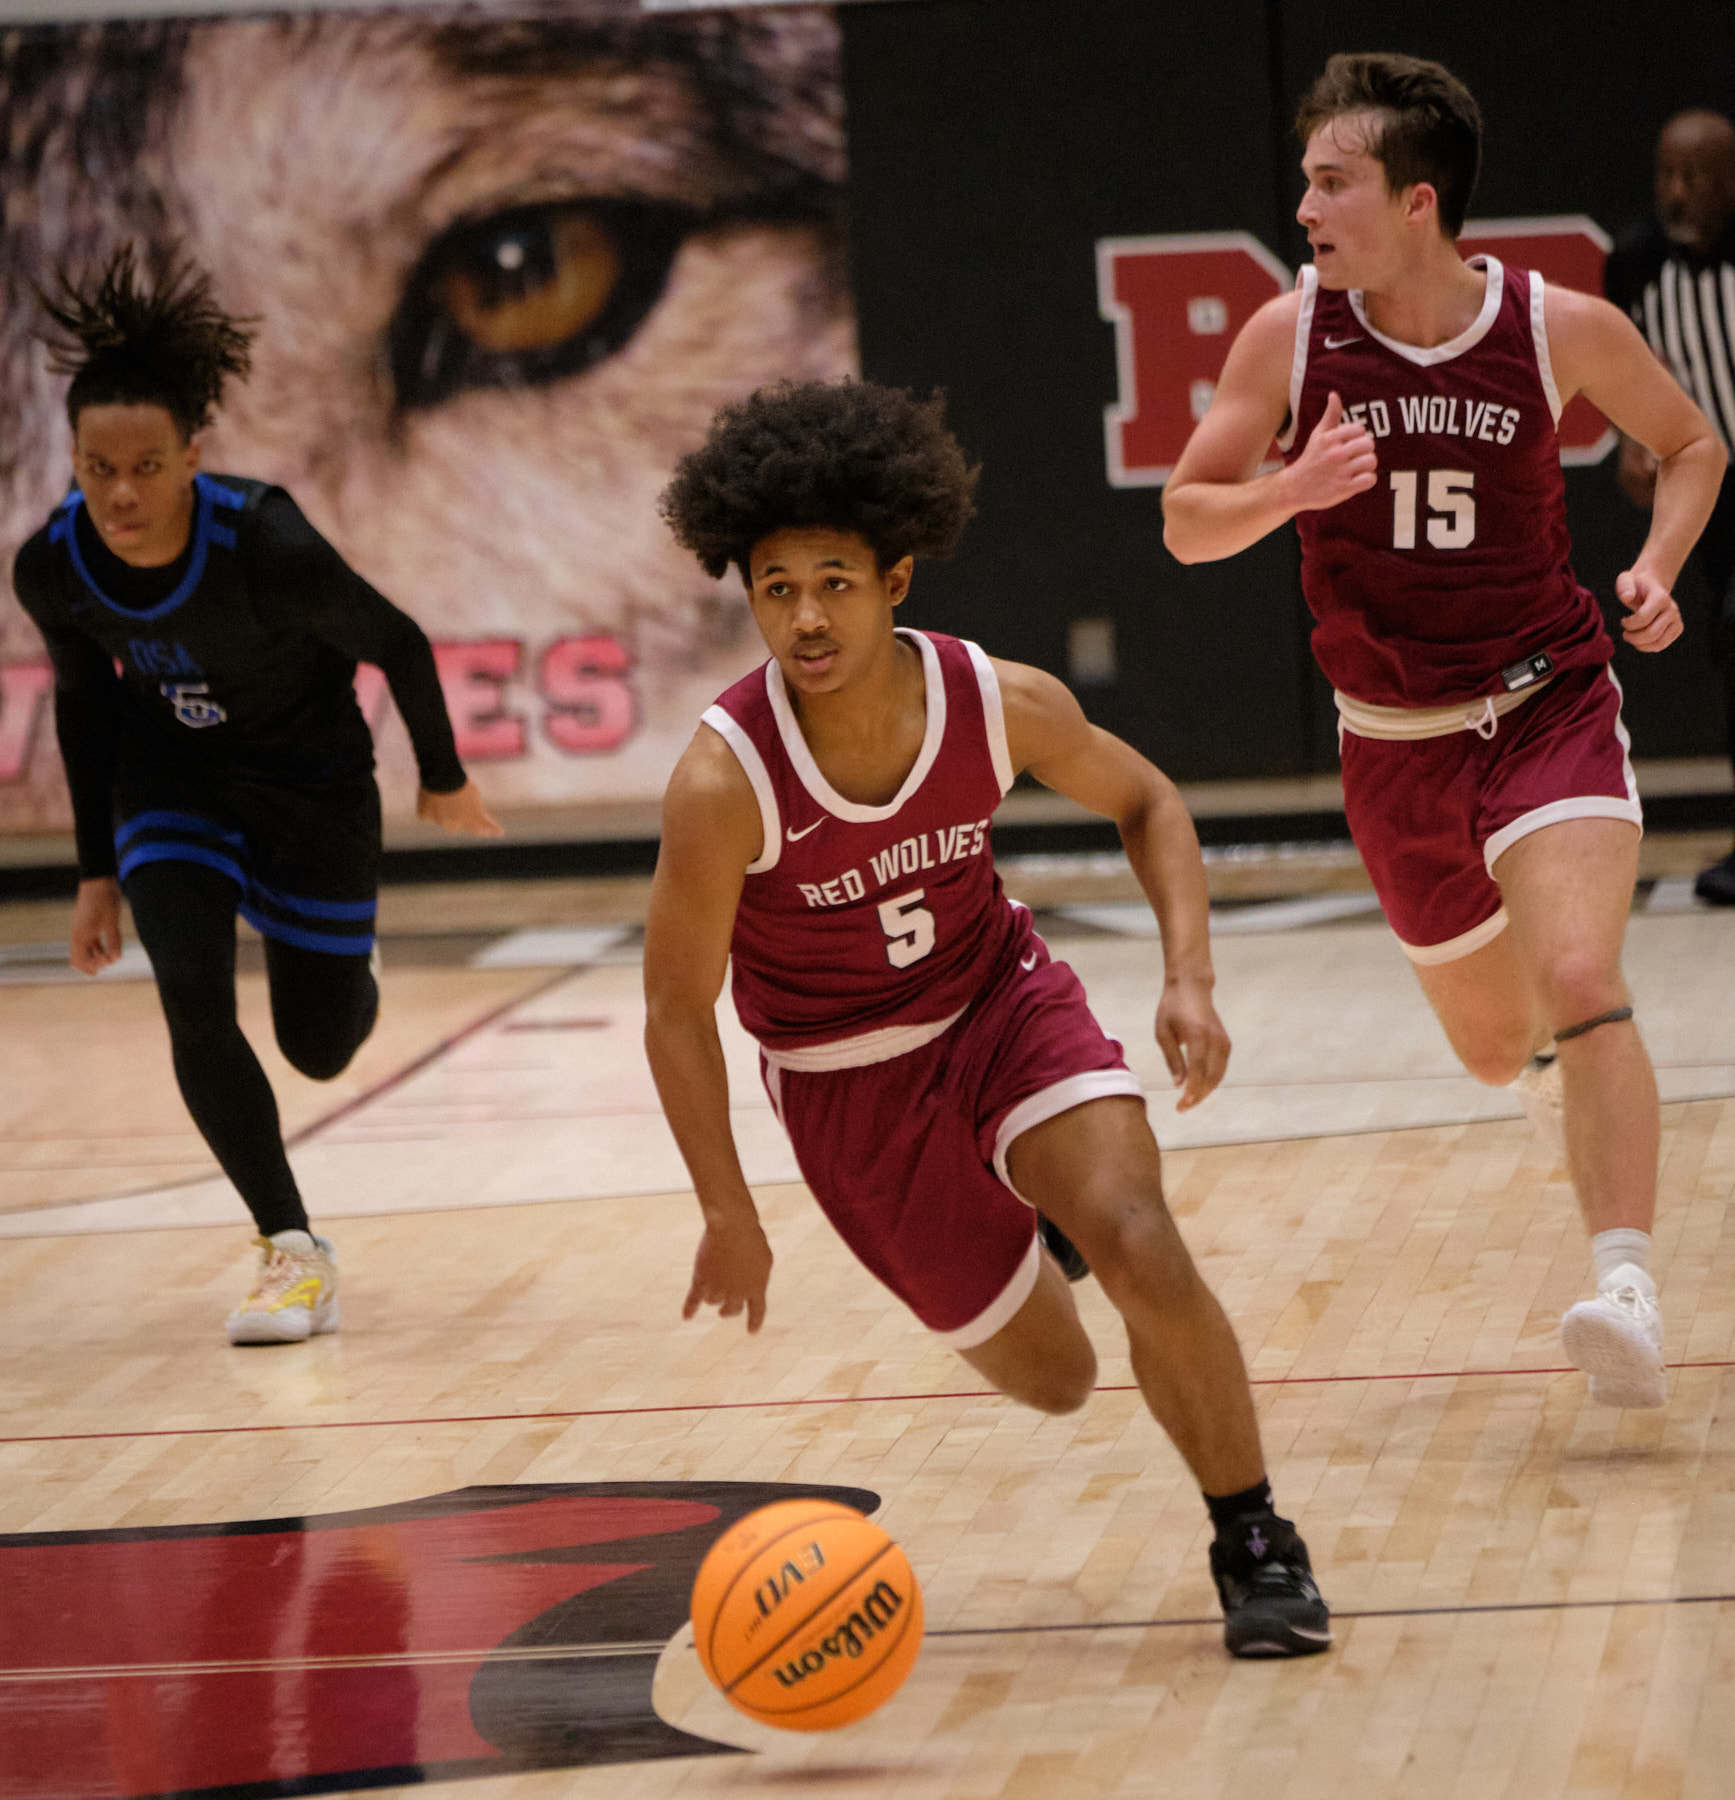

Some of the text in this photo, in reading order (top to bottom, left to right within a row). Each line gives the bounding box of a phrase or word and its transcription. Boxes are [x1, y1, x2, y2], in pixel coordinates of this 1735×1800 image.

[1340, 394, 1521, 446] ED WOLVES
[1389, 469, 1476, 550] 15
[160, 680, 227, 729] 5
[1534, 658, 1547, 672] M
[796, 818, 989, 908] RED WOLVES
[876, 887, 936, 970] 5
[772, 1579, 904, 1689] Wilson
